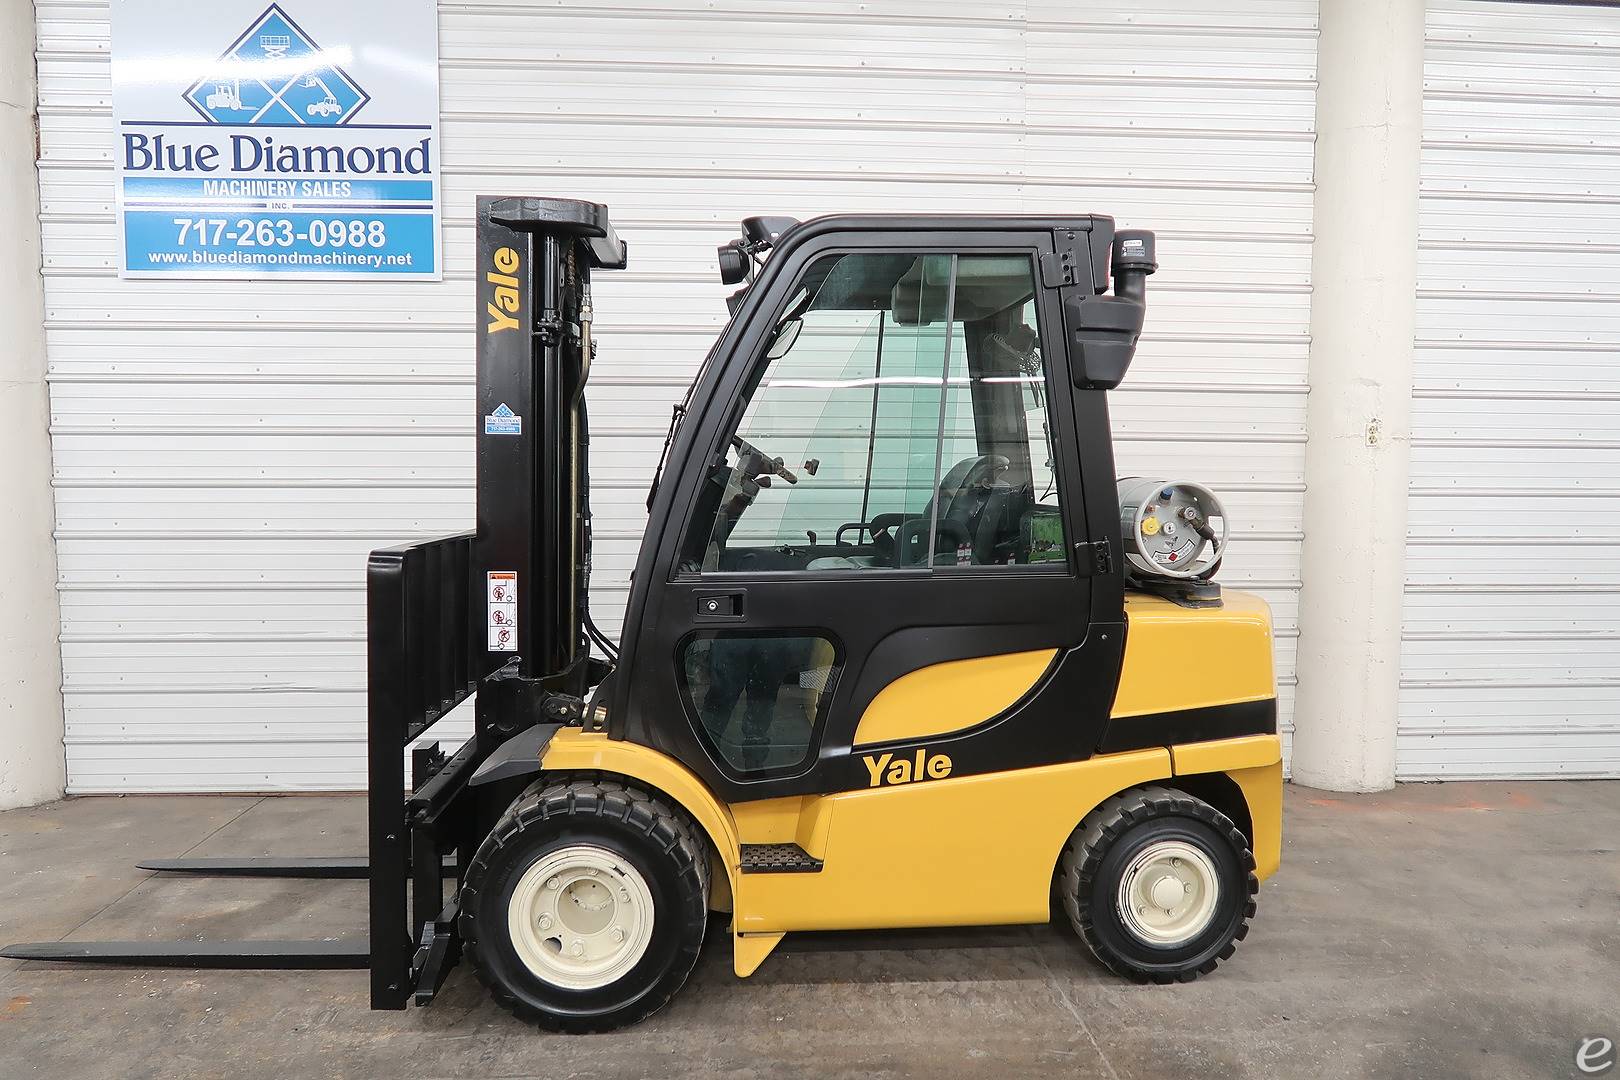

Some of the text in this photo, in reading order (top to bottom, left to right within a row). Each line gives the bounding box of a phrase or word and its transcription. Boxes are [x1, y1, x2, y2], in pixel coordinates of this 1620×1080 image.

[122, 133, 432, 174] Blue Diamond
[203, 179, 351, 198] MACHINERY SALES
[271, 202, 290, 210] INC.
[173, 218, 386, 248] 717-263-0988
[148, 250, 412, 267] www.bluediamondmachinery.net
[487, 247, 520, 333] Yale
[862, 748, 953, 787] Yale
